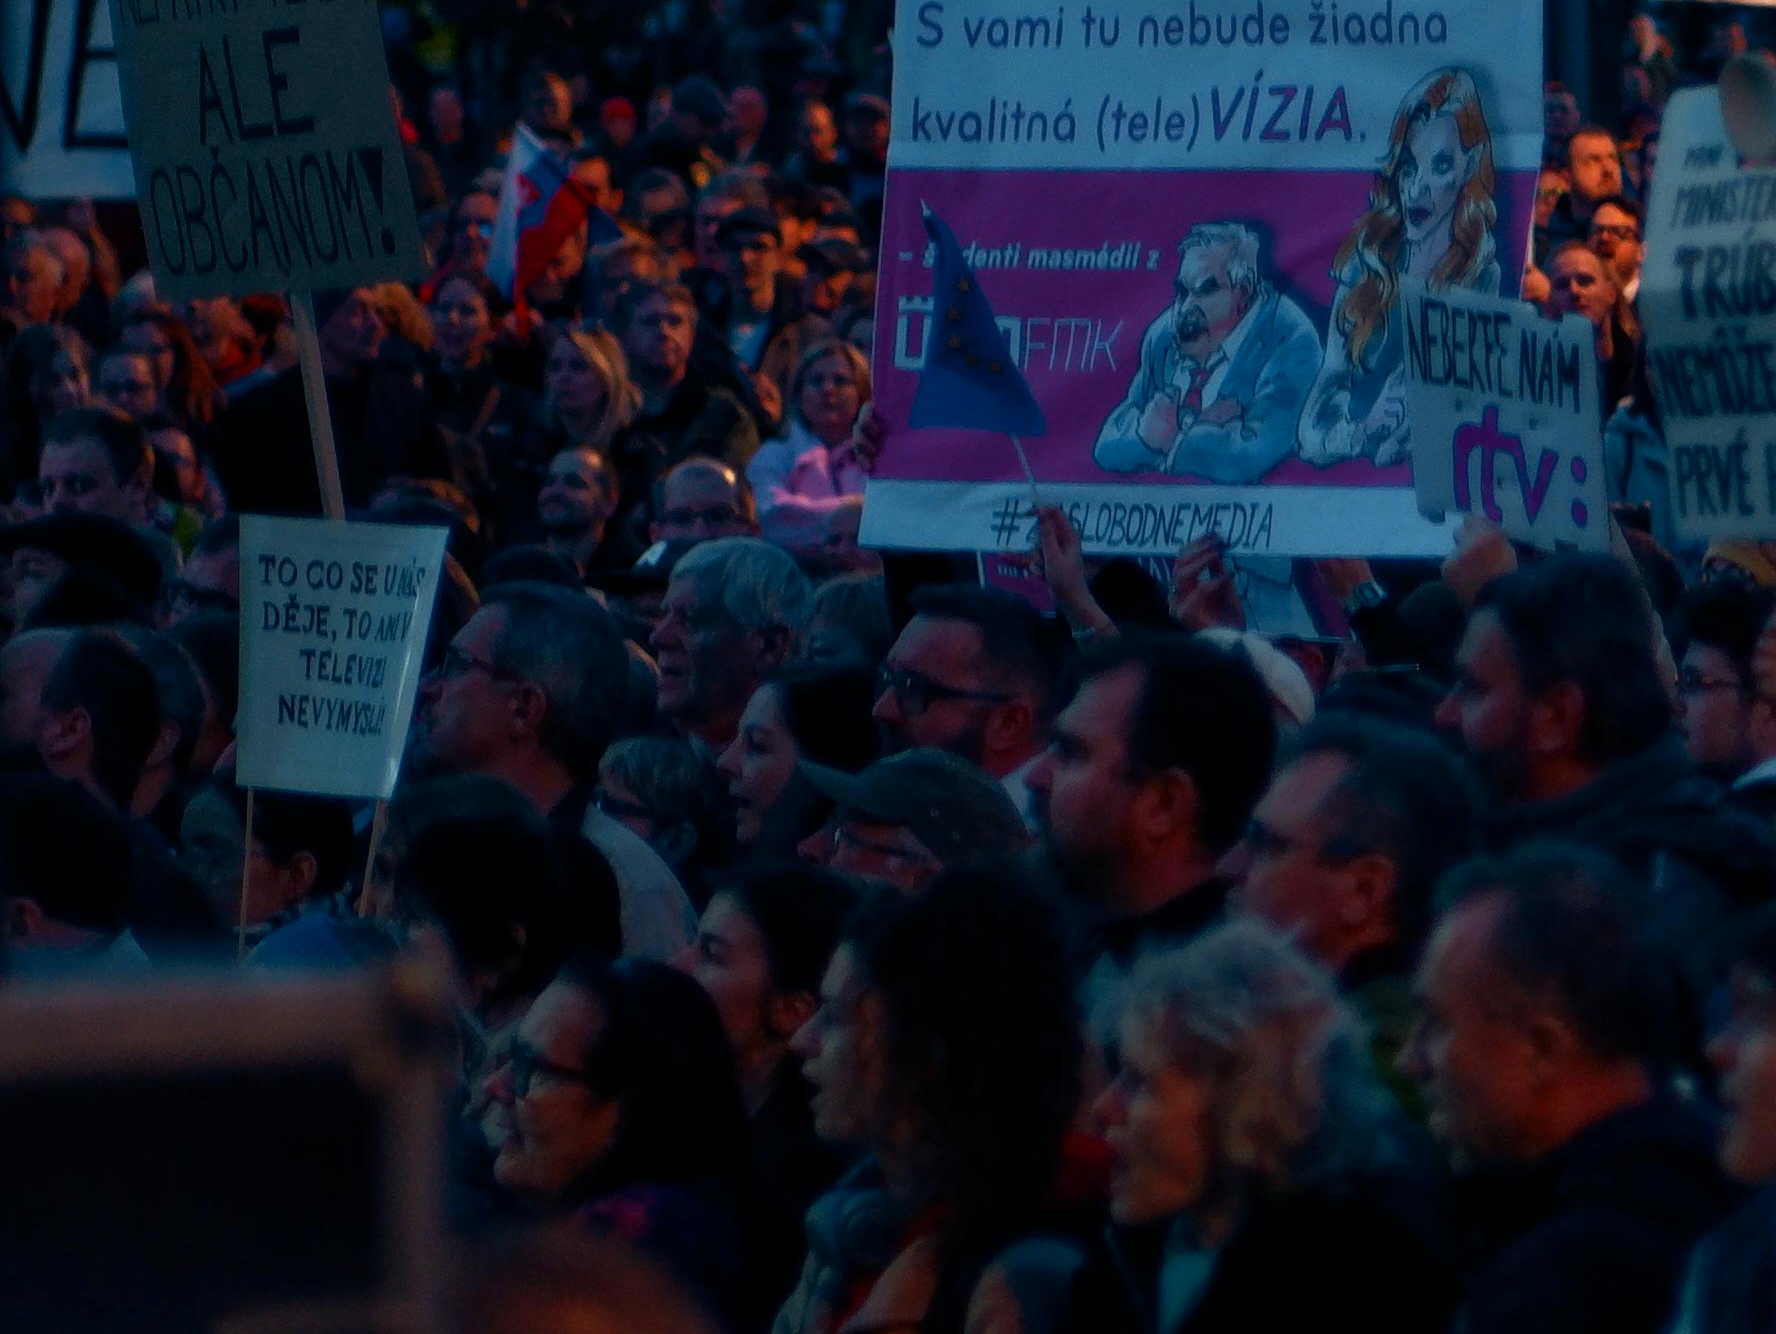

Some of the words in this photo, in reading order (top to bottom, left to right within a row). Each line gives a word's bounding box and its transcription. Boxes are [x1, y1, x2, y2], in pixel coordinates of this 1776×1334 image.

[915, 0, 945, 49] S
[963, 6, 1064, 49] vami
[1081, 6, 1121, 48] tu
[199, 26, 316, 147] ALE
[911, 95, 1077, 145] kvalitná
[150, 146, 396, 276] OBČANOM!
[1406, 294, 1513, 398] NEBERTE
[1519, 327, 1581, 415] NÁM
[1674, 426, 1754, 518] PRVÉ
[258, 554, 298, 588] TO
[306, 559, 343, 590] CO
[350, 560, 377, 596] SE
[261, 593, 337, 643] DĚJE,
[342, 607, 373, 641] TO
